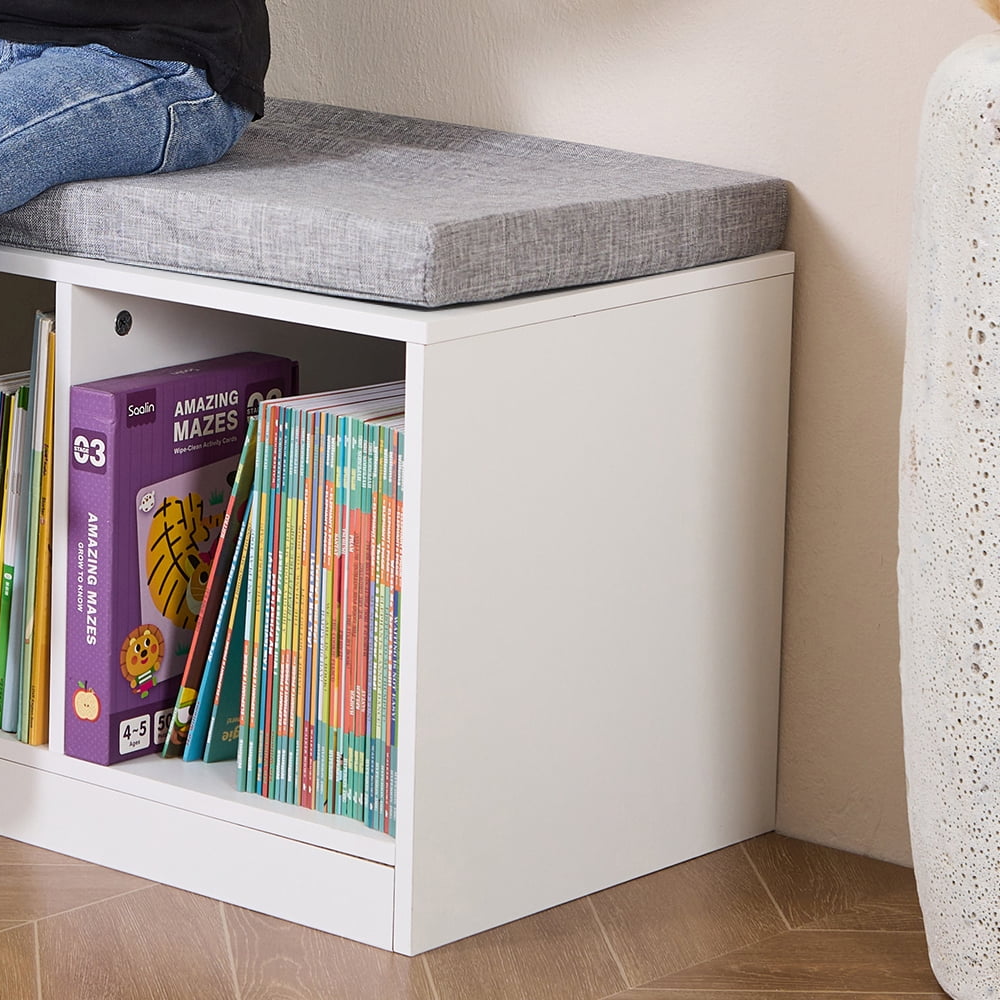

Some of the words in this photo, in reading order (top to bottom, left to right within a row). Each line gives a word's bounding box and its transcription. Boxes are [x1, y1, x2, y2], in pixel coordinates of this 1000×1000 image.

[174, 389, 239, 417] AMAZING
[173, 409, 239, 442] MAZES
[73, 435, 107, 468] 03
[174, 443, 202, 454] Wipe-Clean
[203, 437, 222, 450] Activity
[222, 435, 238, 445] Cards
[87, 512, 98, 586] AMAZING
[77, 572, 84, 583] TO
[86, 590, 97, 646] MAZES
